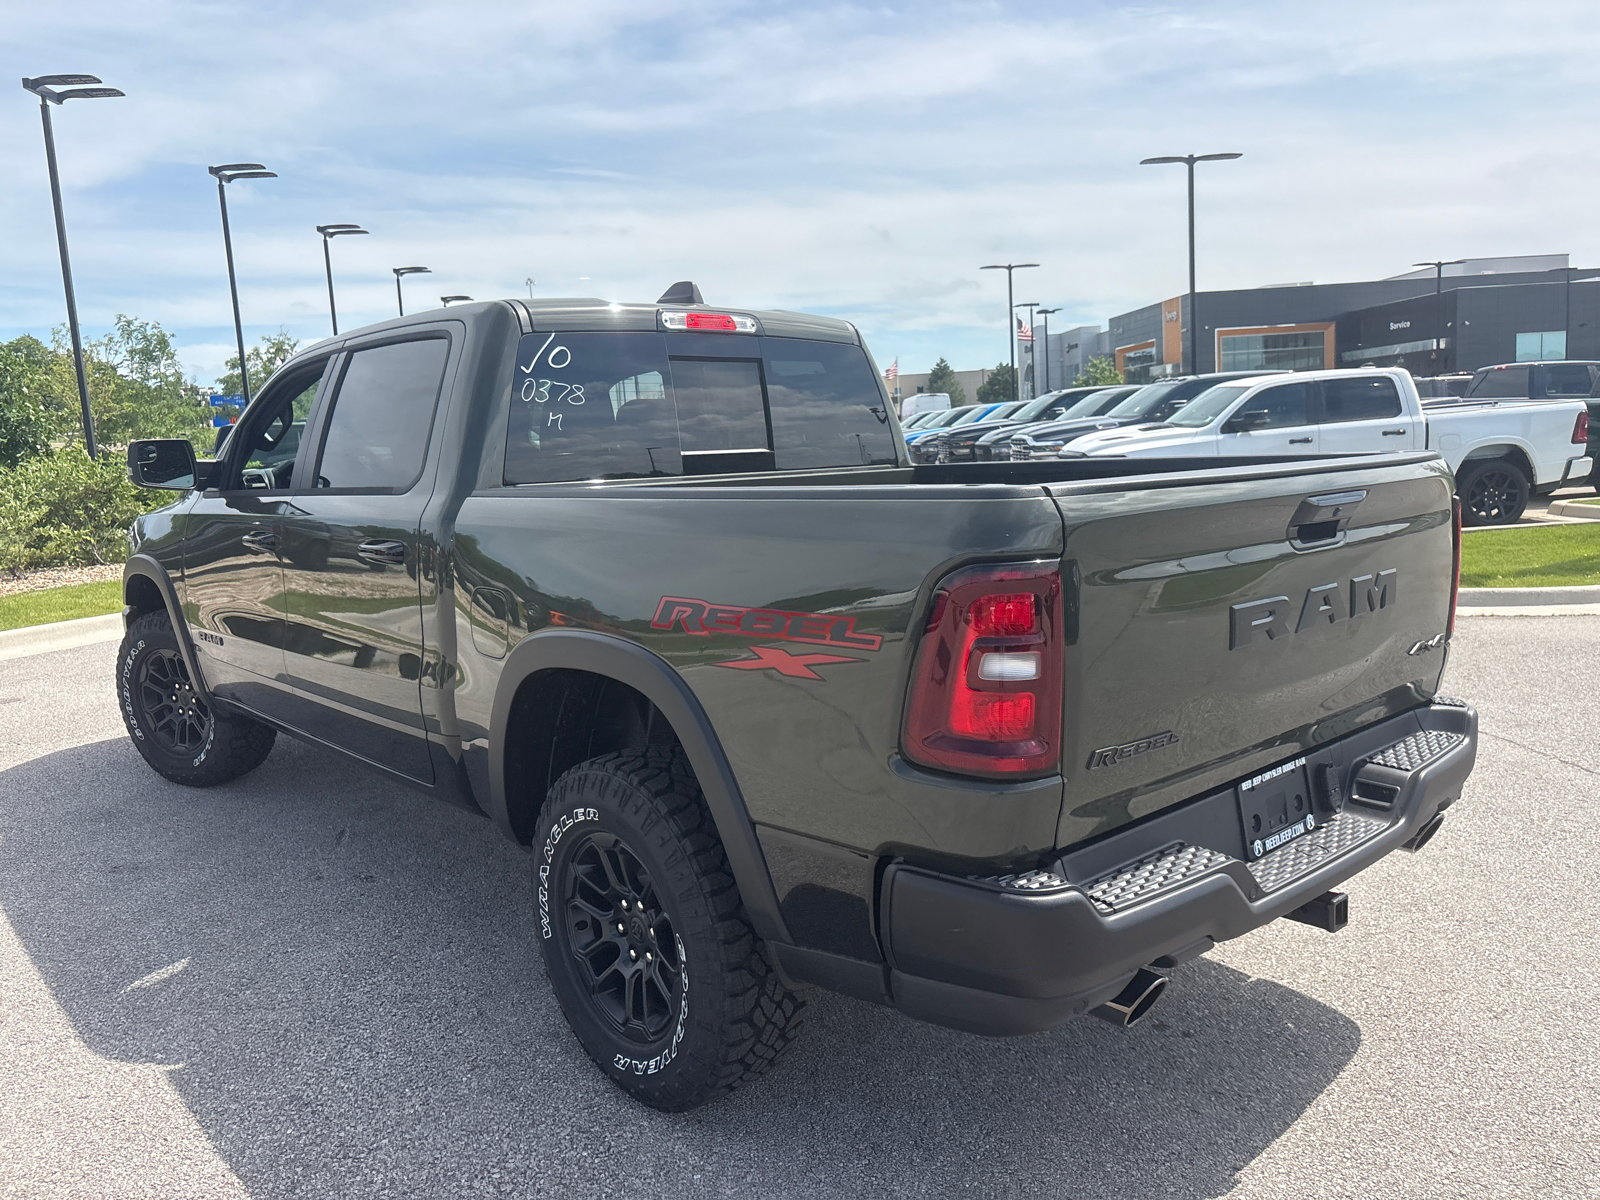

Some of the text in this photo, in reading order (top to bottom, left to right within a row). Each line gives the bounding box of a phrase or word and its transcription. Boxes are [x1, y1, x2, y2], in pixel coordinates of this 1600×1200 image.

[1389, 320, 1411, 331] Service
[521, 378, 585, 405] 0378
[650, 595, 884, 651] REBEL
[1229, 567, 1397, 651] RAM
[711, 645, 870, 682] X
[122, 639, 146, 740] GOODYEAR
[1085, 730, 1180, 770] REBEL
[1241, 756, 1306, 791] REED JEEP CHRYSLER DODGE RAM
[1265, 822, 1305, 852] REEDJEEP.COM
[538, 807, 599, 939] WRANGLER
